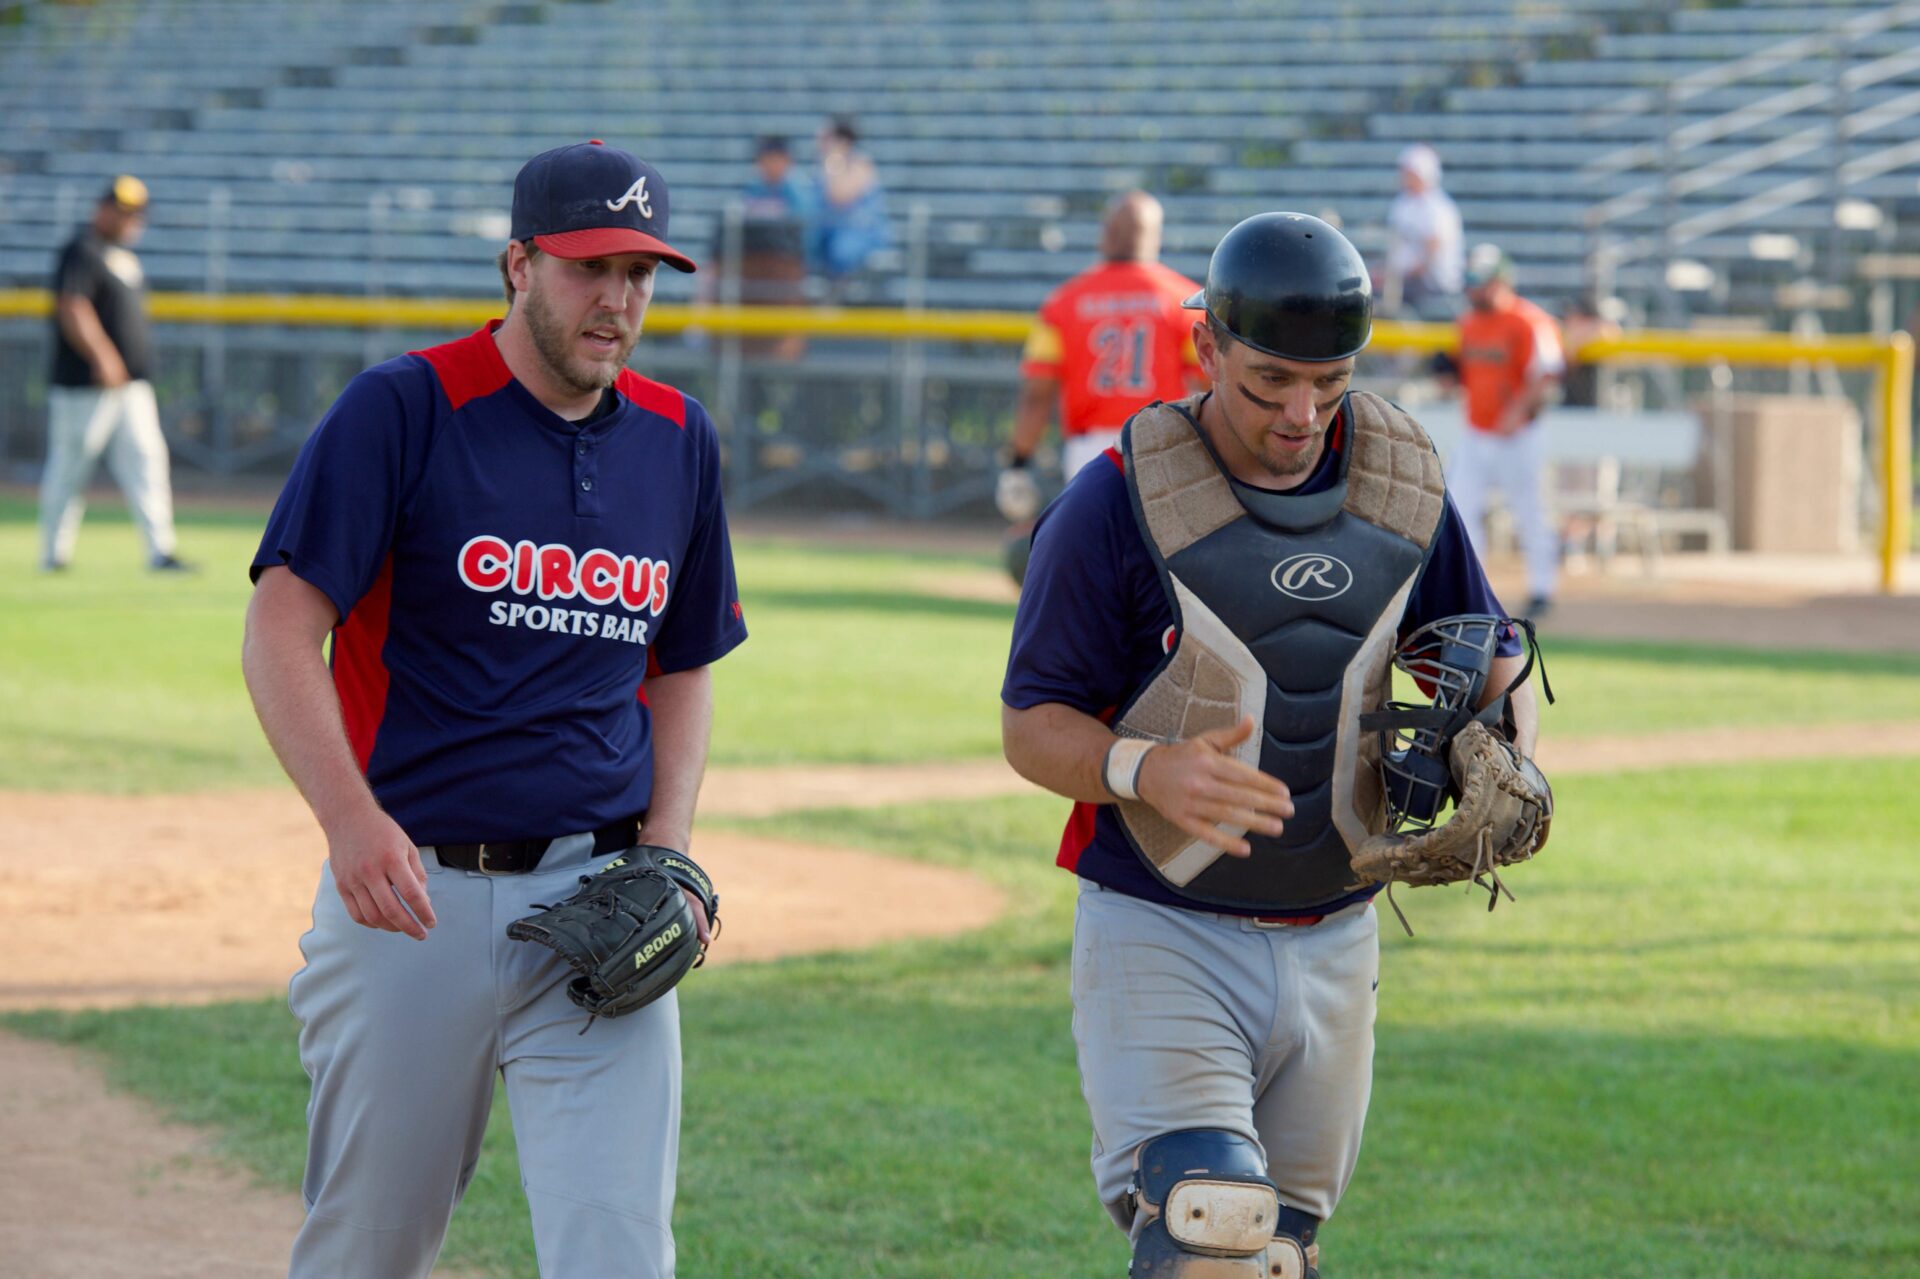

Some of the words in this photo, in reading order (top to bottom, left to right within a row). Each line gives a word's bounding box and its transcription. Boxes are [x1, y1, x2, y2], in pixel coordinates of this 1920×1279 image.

[606, 175, 653, 219] A
[1087, 317, 1156, 398] 21
[458, 535, 669, 617] CIRCUS
[489, 600, 600, 637] SPORTS
[601, 614, 648, 645] BAR
[634, 922, 682, 969] A2000
